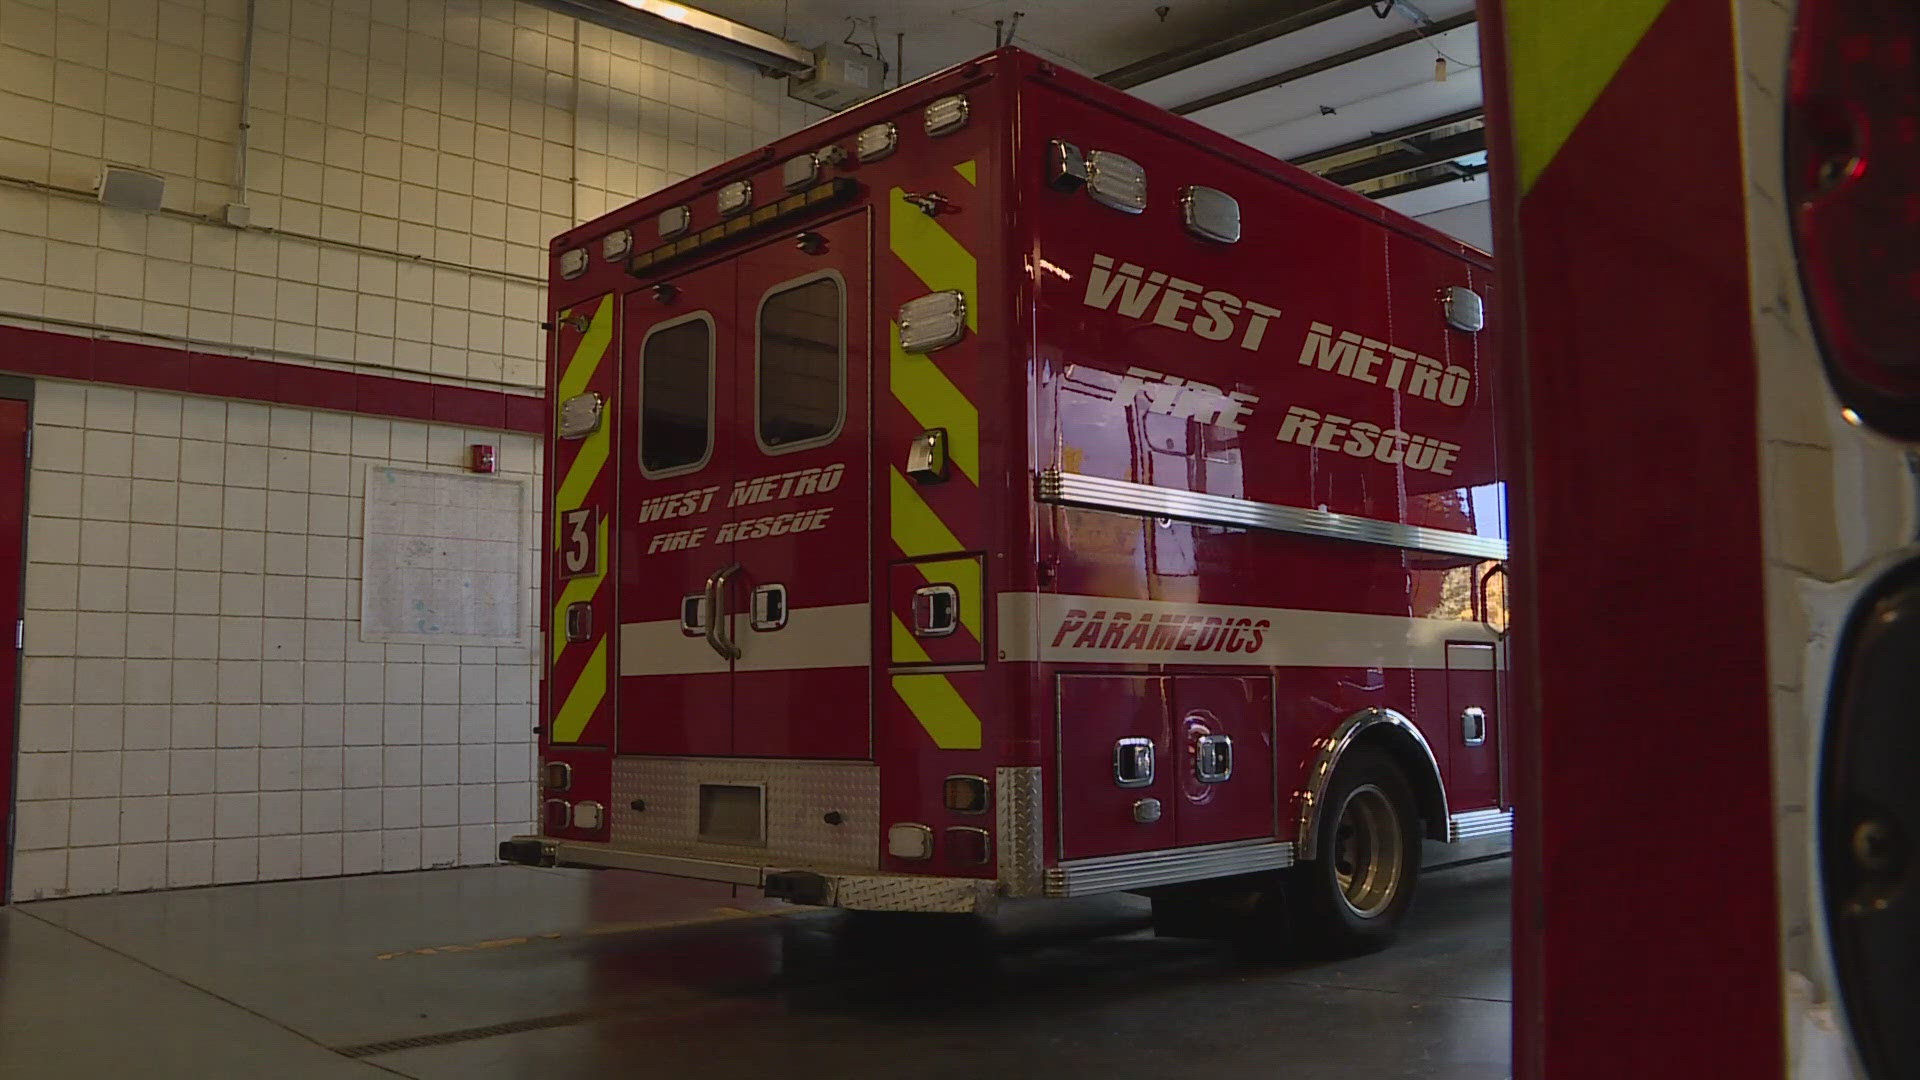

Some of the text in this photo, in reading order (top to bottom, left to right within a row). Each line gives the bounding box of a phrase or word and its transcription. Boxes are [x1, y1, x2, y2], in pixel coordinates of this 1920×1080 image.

[1084, 254, 1471, 407] WEST METRO
[1110, 366, 1461, 476] FIRE RESCUE
[639, 463, 845, 523] WEST METRO
[565, 510, 590, 572] 3
[648, 507, 834, 554] FIRE RESCUE
[1051, 609, 1270, 654] PARAMEDICS
